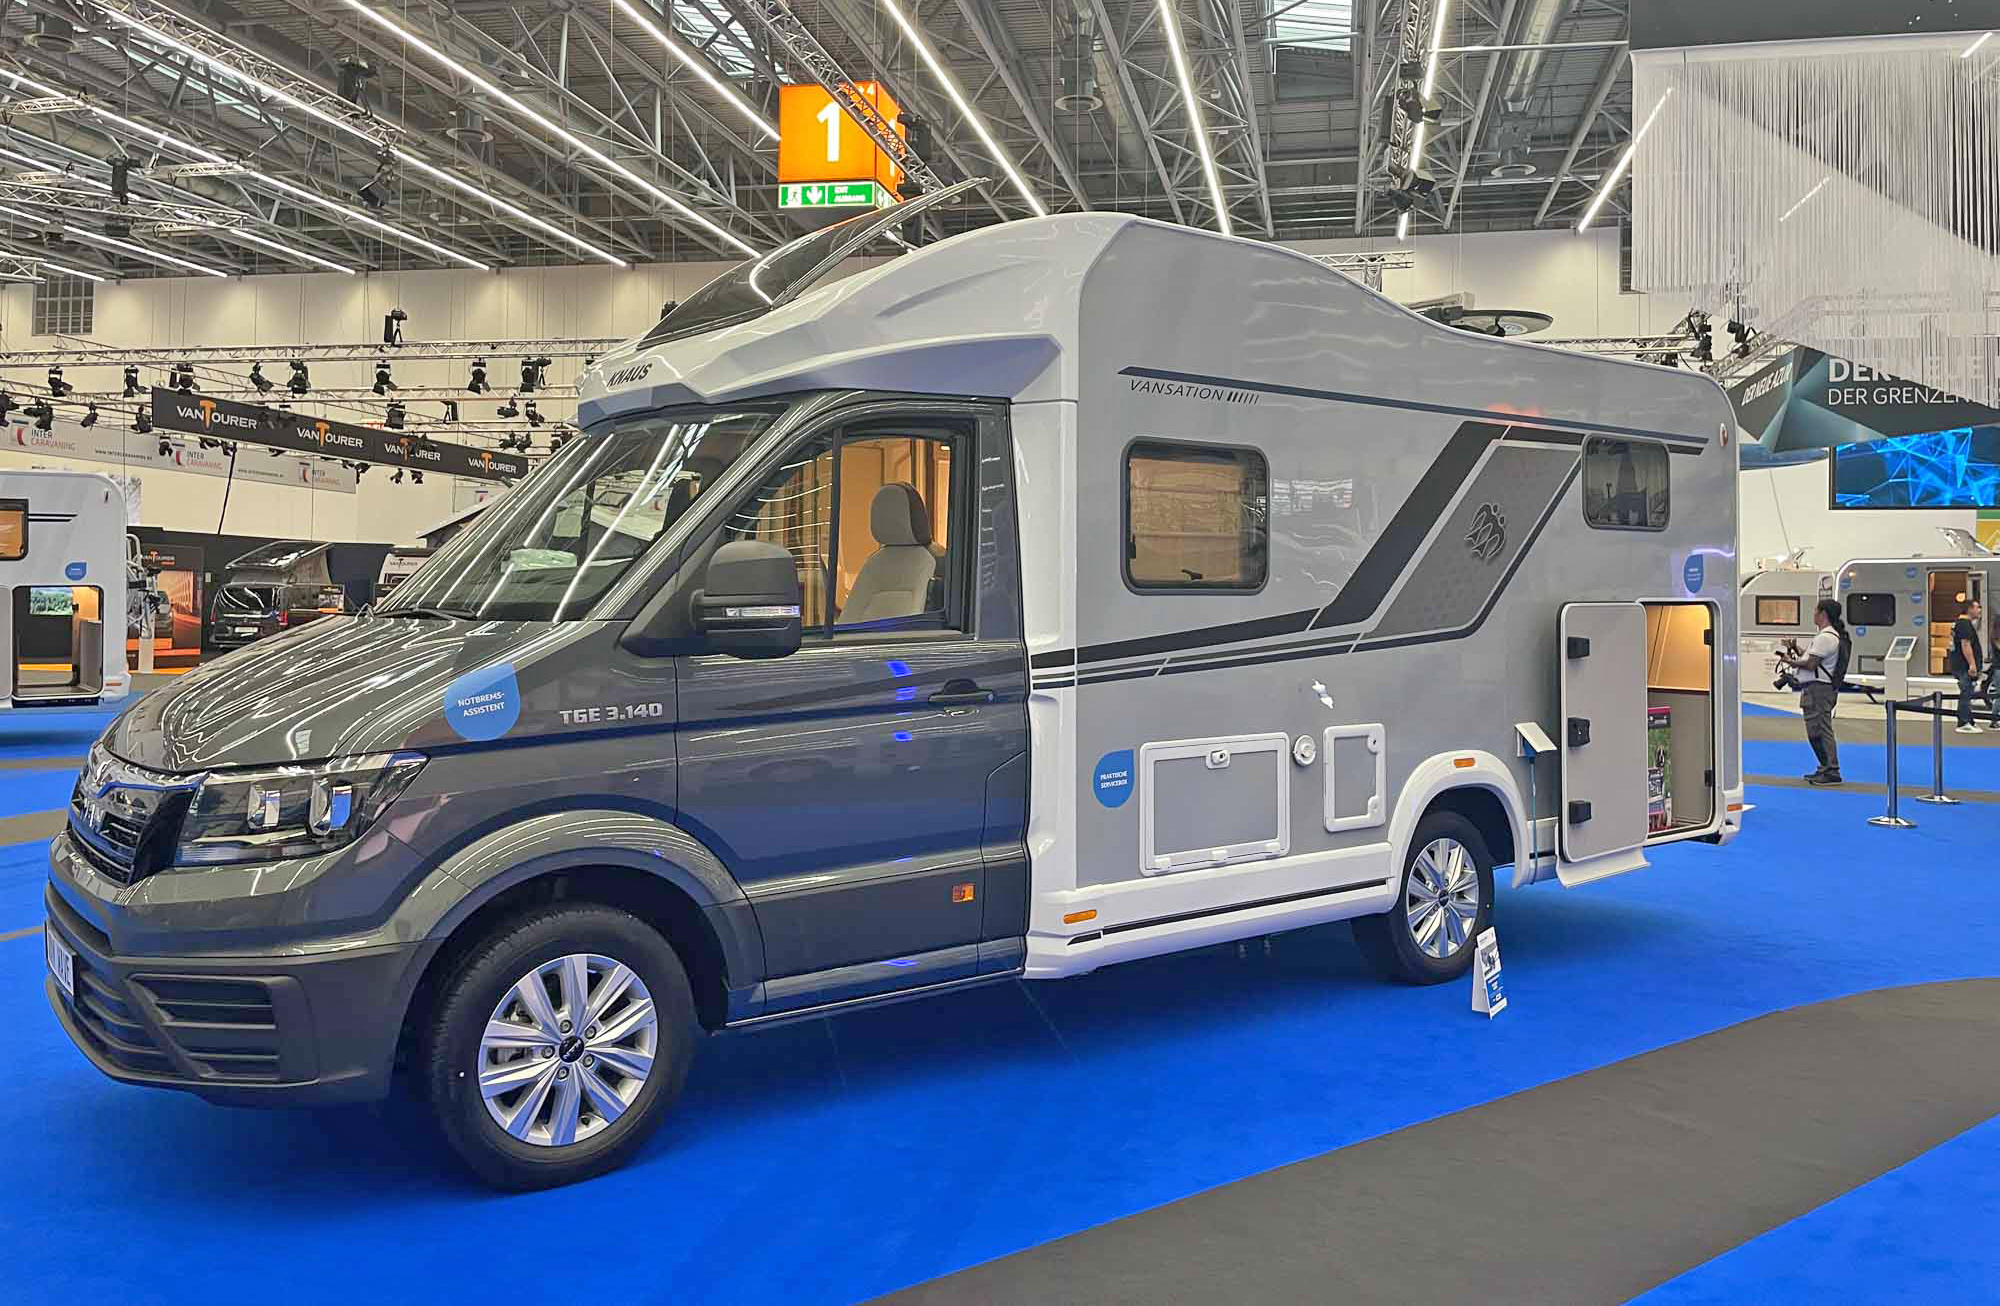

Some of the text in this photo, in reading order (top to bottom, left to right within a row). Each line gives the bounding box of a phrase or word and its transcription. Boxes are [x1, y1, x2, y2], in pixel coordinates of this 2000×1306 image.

[816, 101, 841, 162] 1
[606, 363, 653, 387] KNAUS
[1828, 358, 1891, 382] DER
[1130, 379, 1225, 401] VANSATION
[1828, 388, 1868, 405] DER
[176, 399, 258, 430] VANTOURER
[30, 438, 77, 451] CARAVANING
[31, 429, 53, 440] INTER
[297, 422, 364, 448] VANTOURER
[384, 437, 441, 463] VANTURER
[467, 452, 517, 474] VANTOURER
[458, 692, 505, 707] NOTBREMS-
[463, 701, 505, 717] ASSISTENT
[559, 702, 663, 725] TGE 3.140
